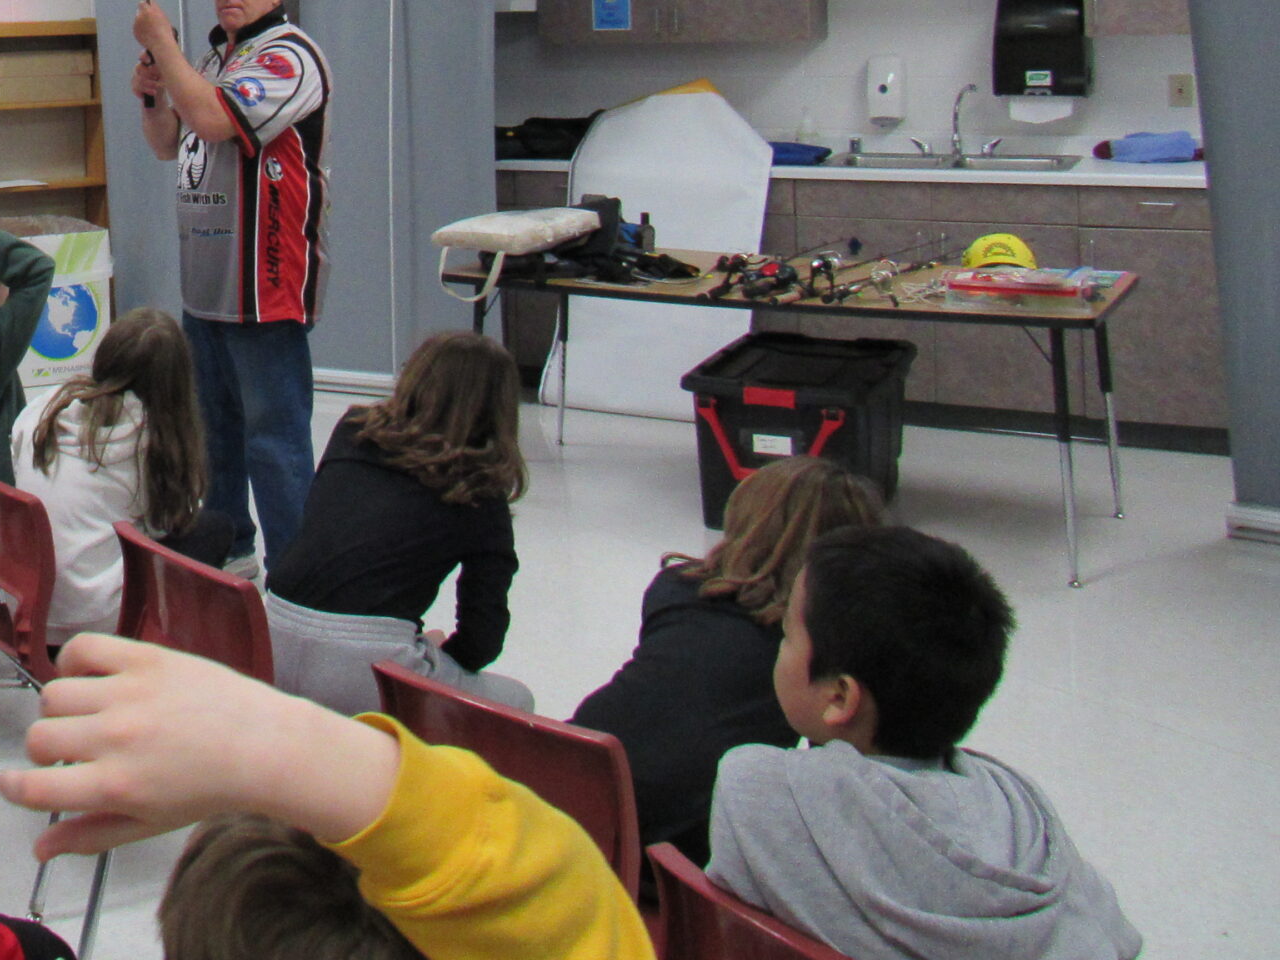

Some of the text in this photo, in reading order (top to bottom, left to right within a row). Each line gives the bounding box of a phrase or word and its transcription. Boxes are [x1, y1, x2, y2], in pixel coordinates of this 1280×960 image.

[192, 192, 211, 205] With
[212, 192, 226, 205] Us
[267, 183, 281, 288] MERCURY
